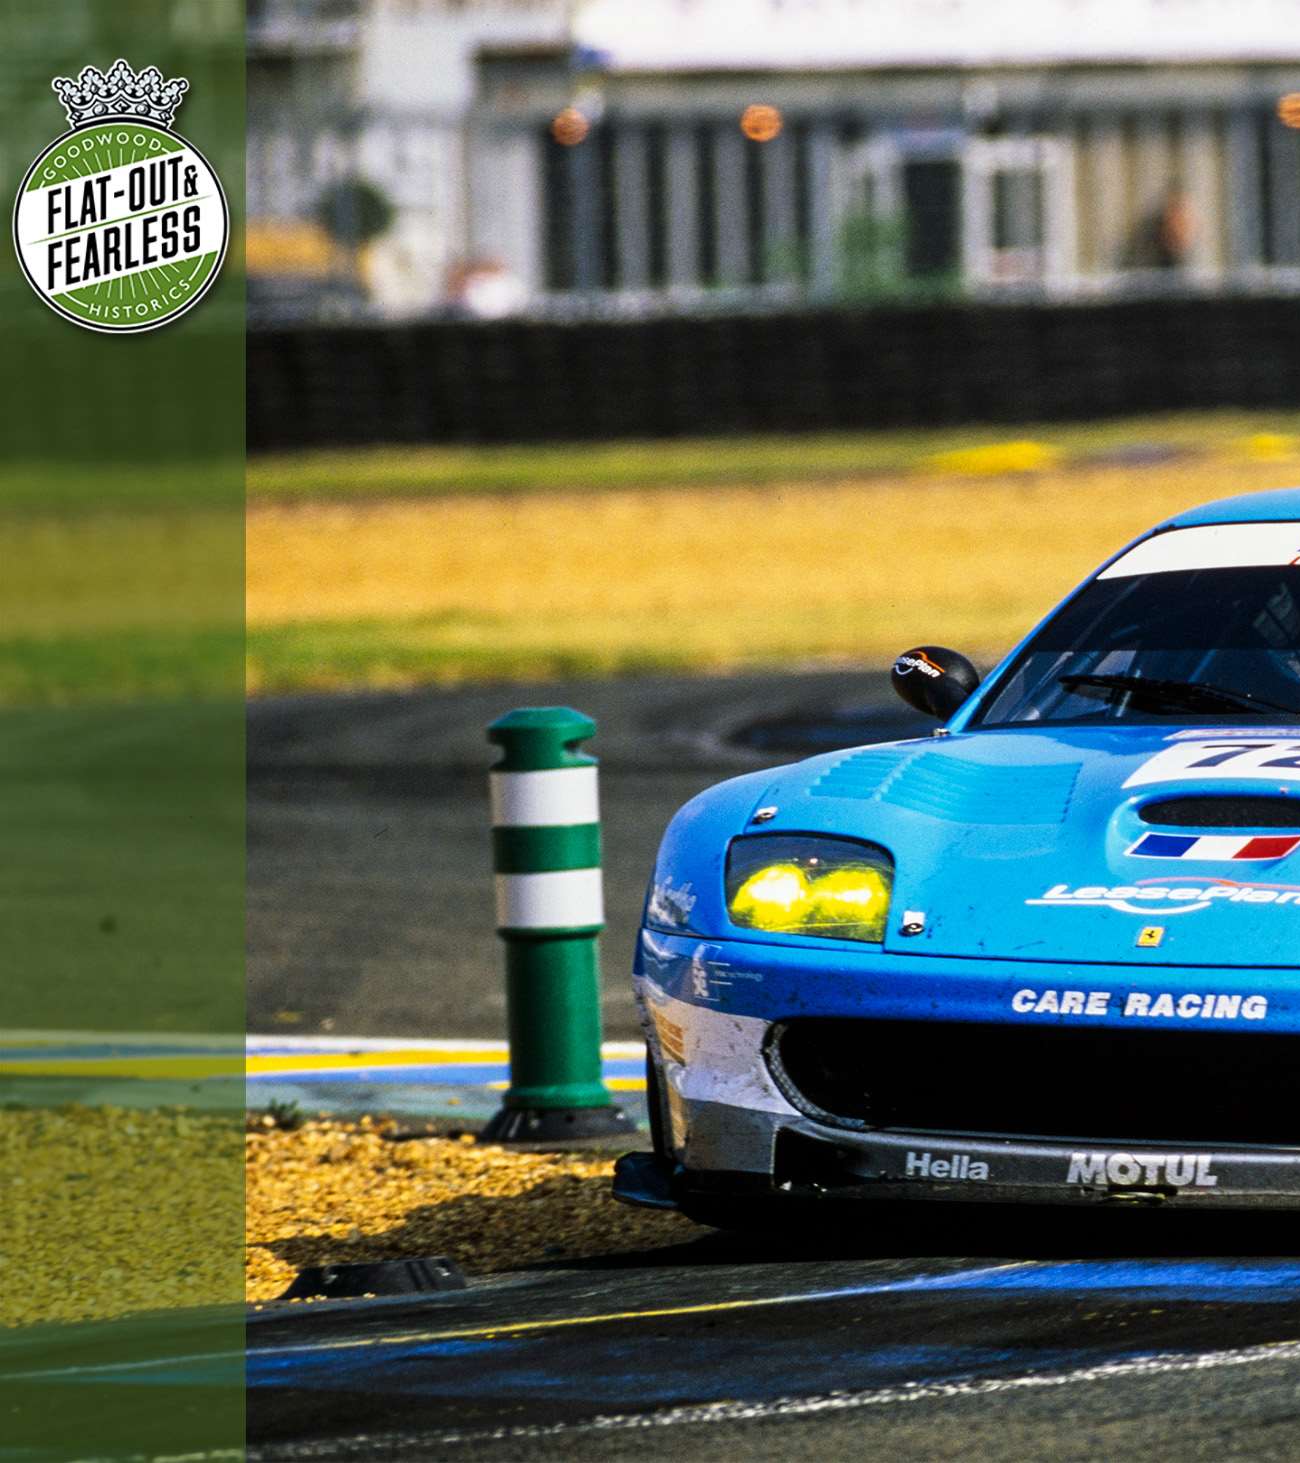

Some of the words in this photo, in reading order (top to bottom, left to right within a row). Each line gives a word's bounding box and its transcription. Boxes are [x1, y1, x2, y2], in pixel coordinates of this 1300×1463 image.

[1011, 989, 1111, 1015] CARE
[1124, 993, 1269, 1020] RACING
[905, 1151, 989, 1181] Hella
[1066, 1152, 1218, 1187] MOTUL
